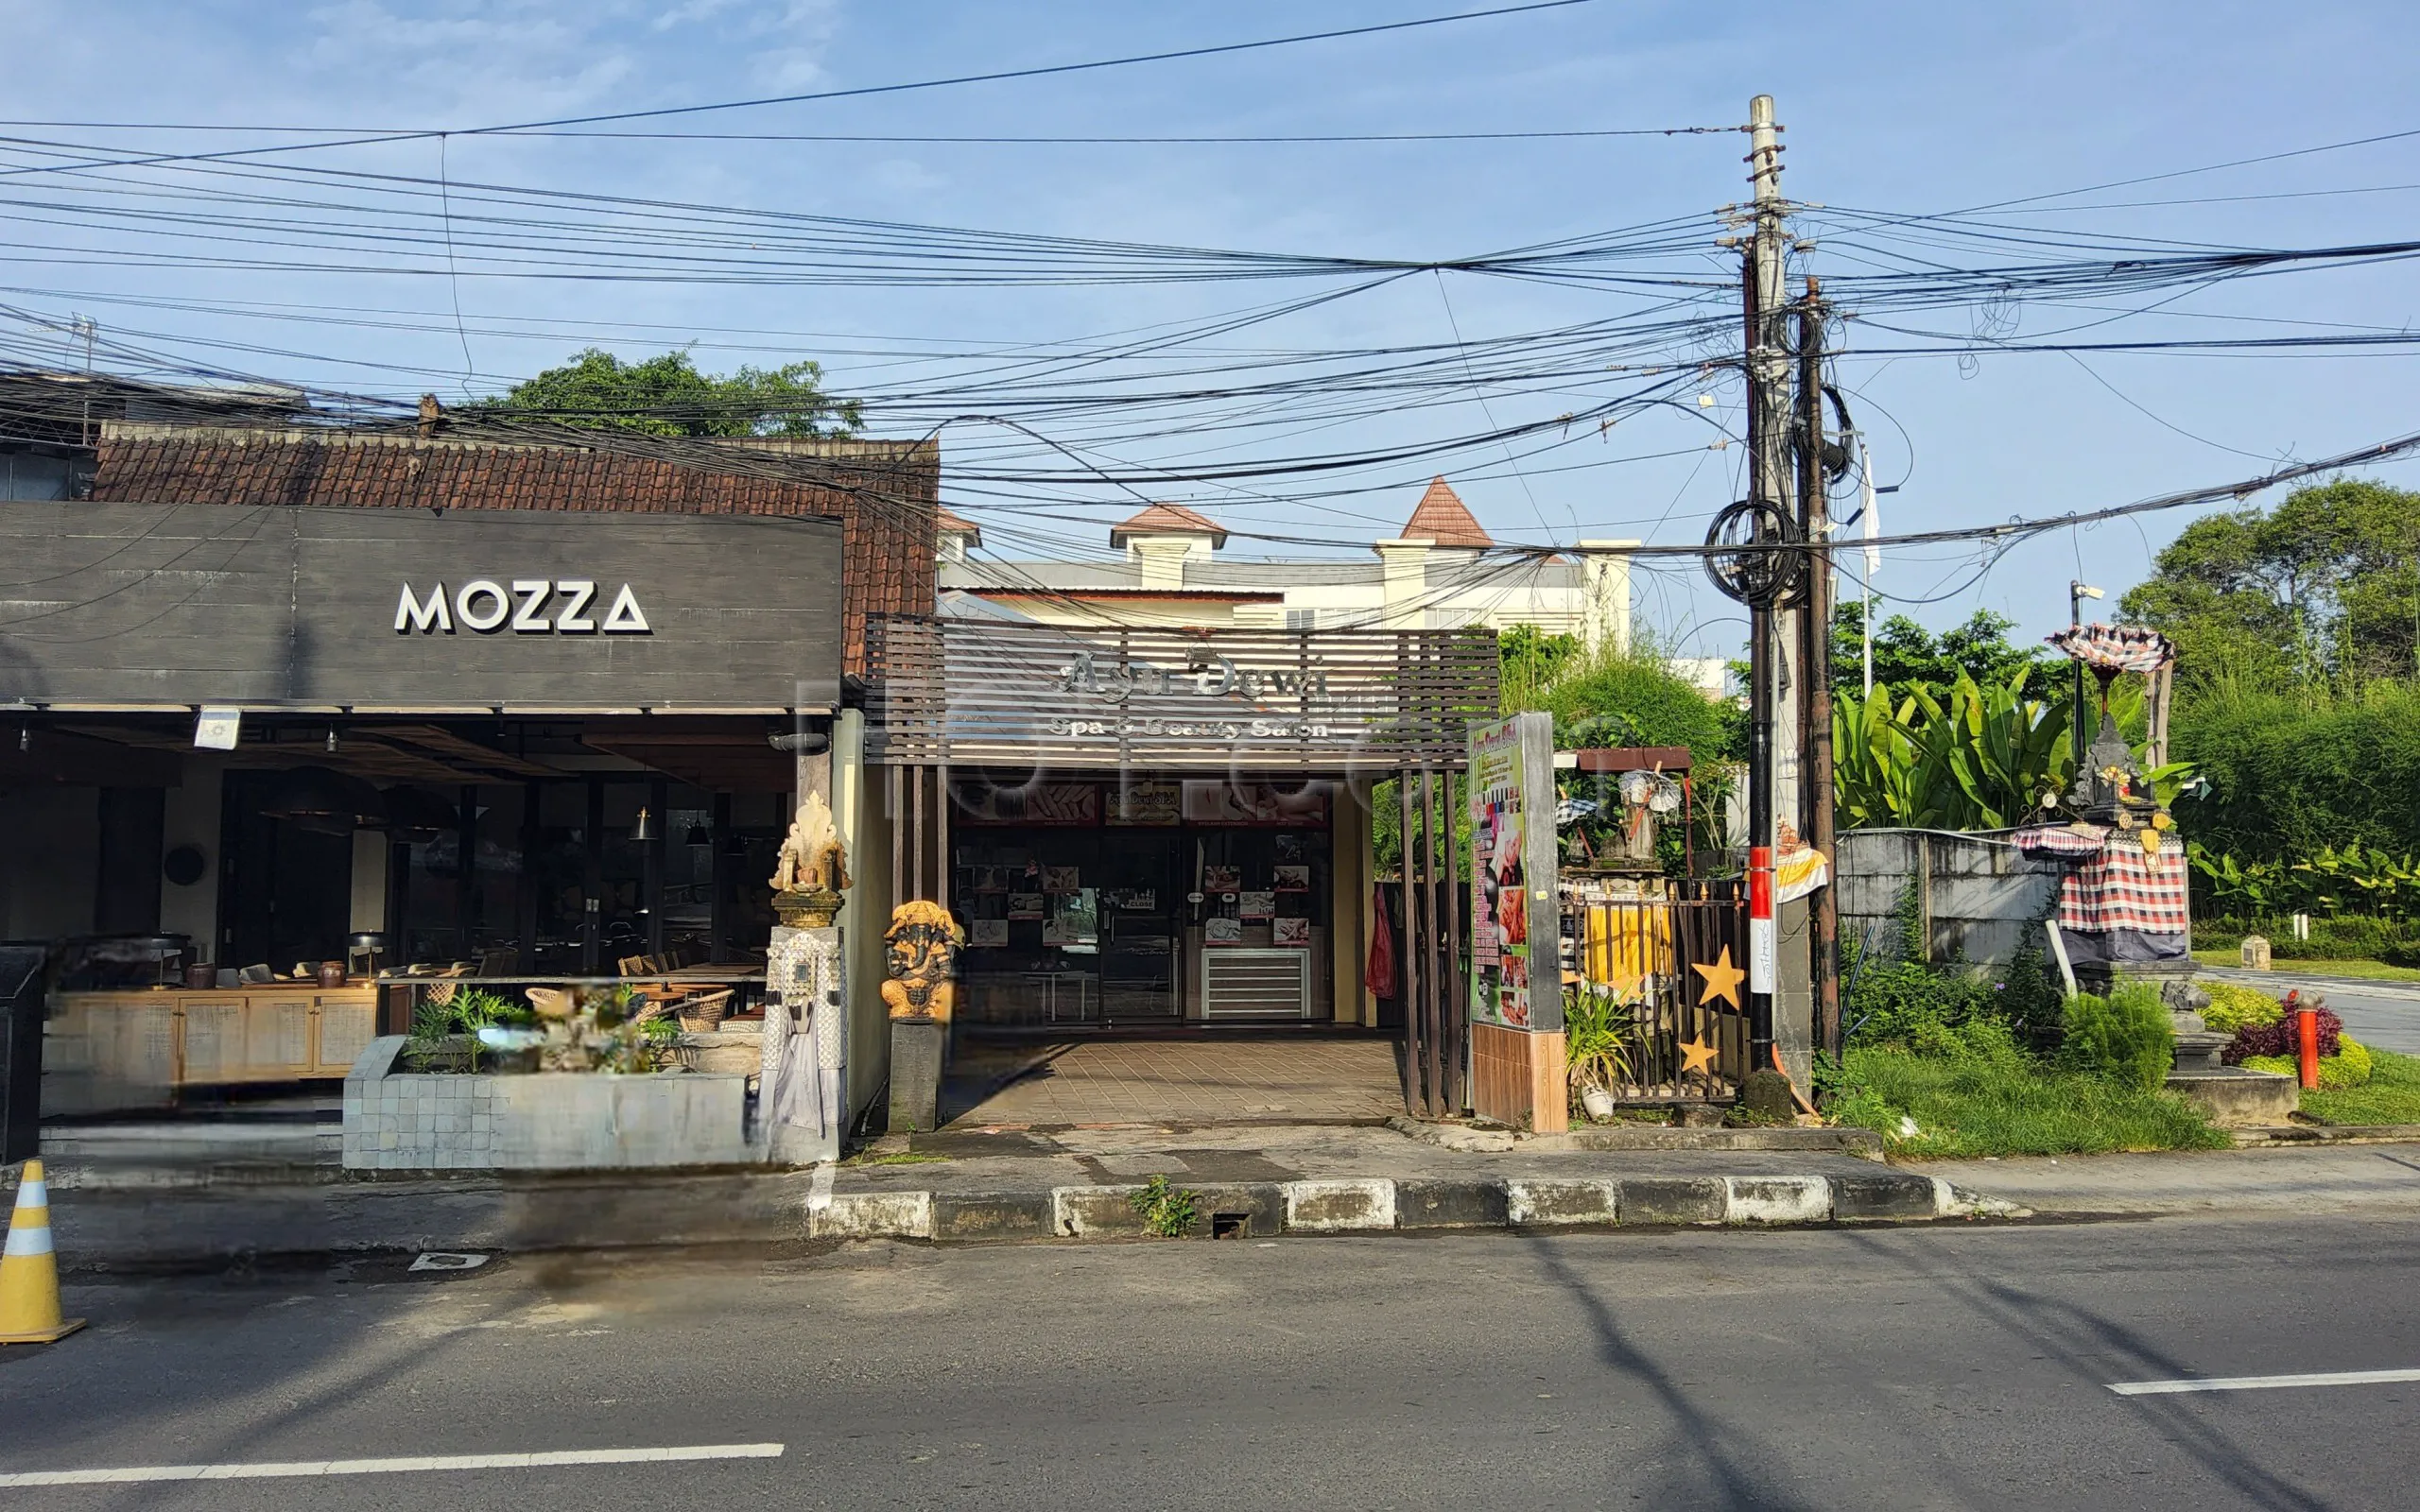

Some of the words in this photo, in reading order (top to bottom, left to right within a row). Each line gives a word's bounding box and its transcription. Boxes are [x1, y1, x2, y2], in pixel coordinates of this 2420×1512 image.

[394, 579, 653, 634] MOZZA
[1050, 650, 1173, 703] Ayu
[1184, 646, 1330, 698] Dewi
[1049, 717, 1106, 737] Spa
[1113, 717, 1134, 736] &
[1143, 718, 1242, 740] Beauty
[1250, 718, 1329, 738] Salon
